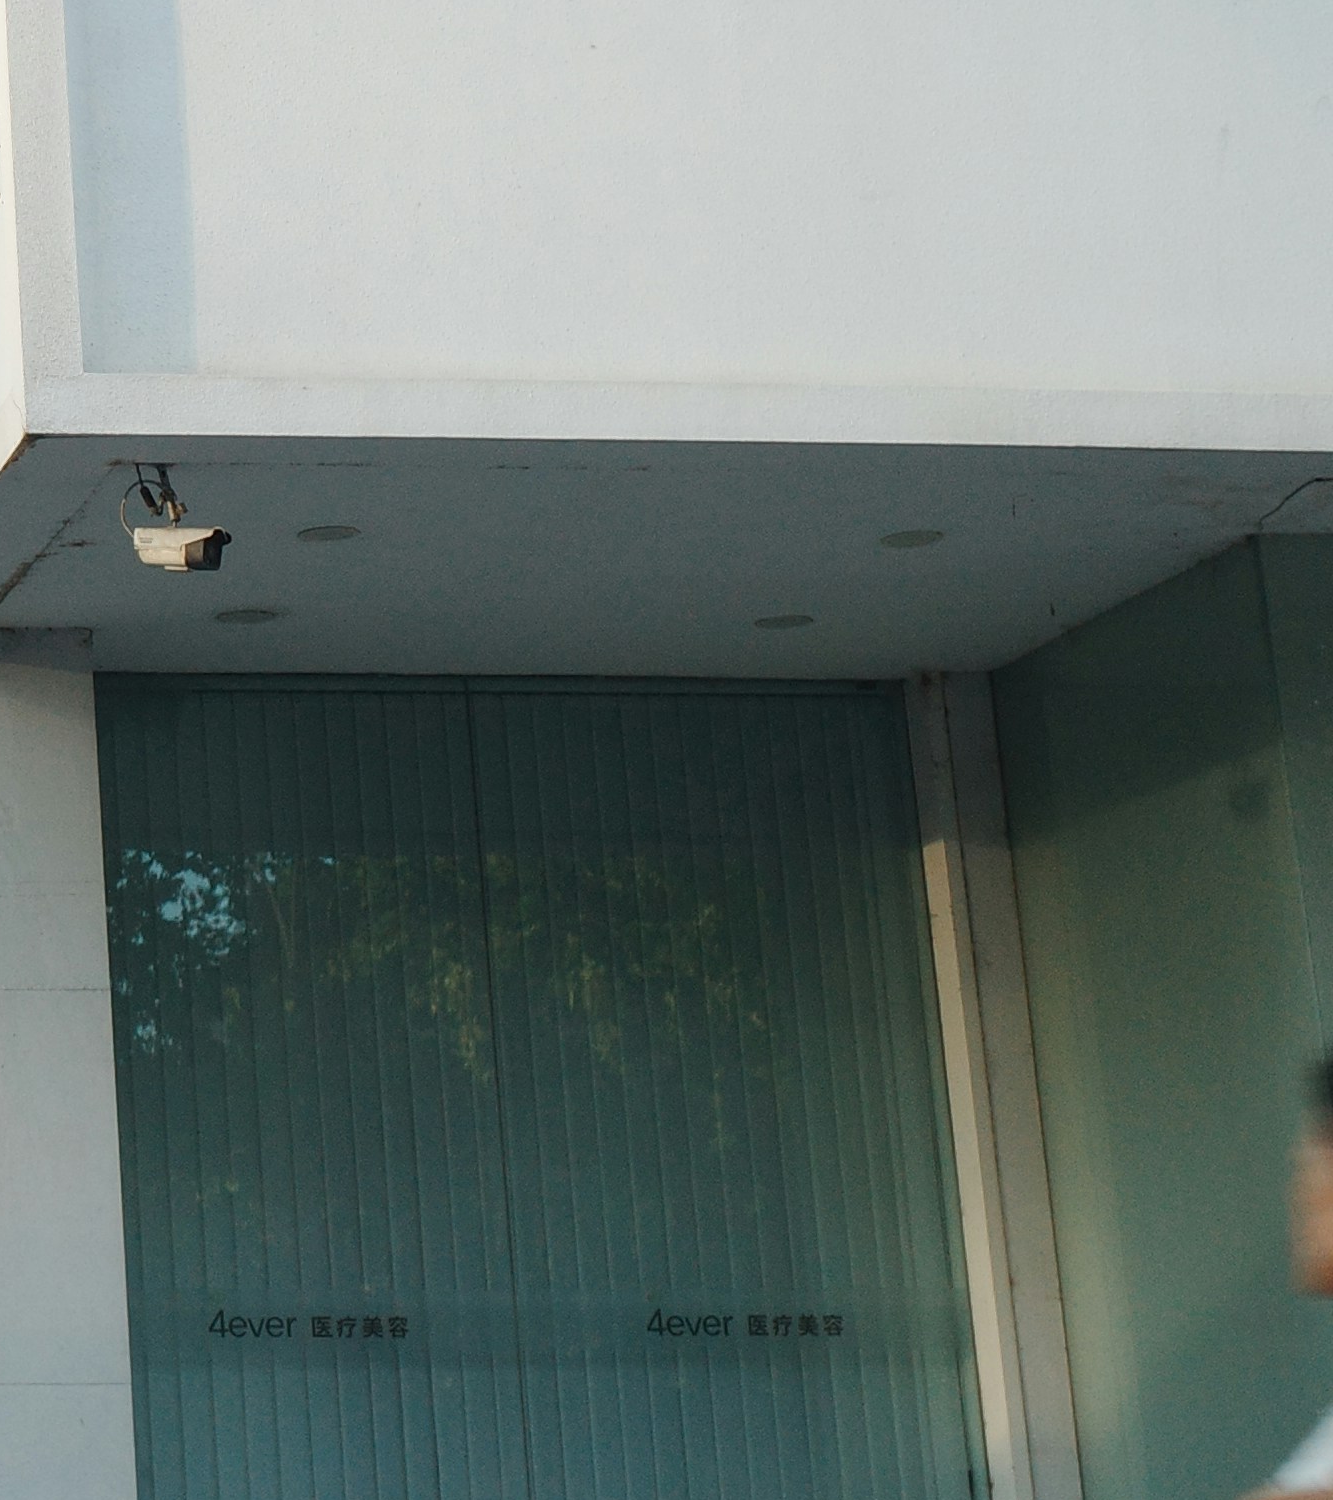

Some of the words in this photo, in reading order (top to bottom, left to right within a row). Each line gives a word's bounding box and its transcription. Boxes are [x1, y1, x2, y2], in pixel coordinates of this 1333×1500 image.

[208, 1309, 298, 1338] 4ever
[311, 1315, 409, 1338] 医疗美容
[647, 1307, 733, 1337] 4ever
[747, 1314, 844, 1337] 医疗美容
